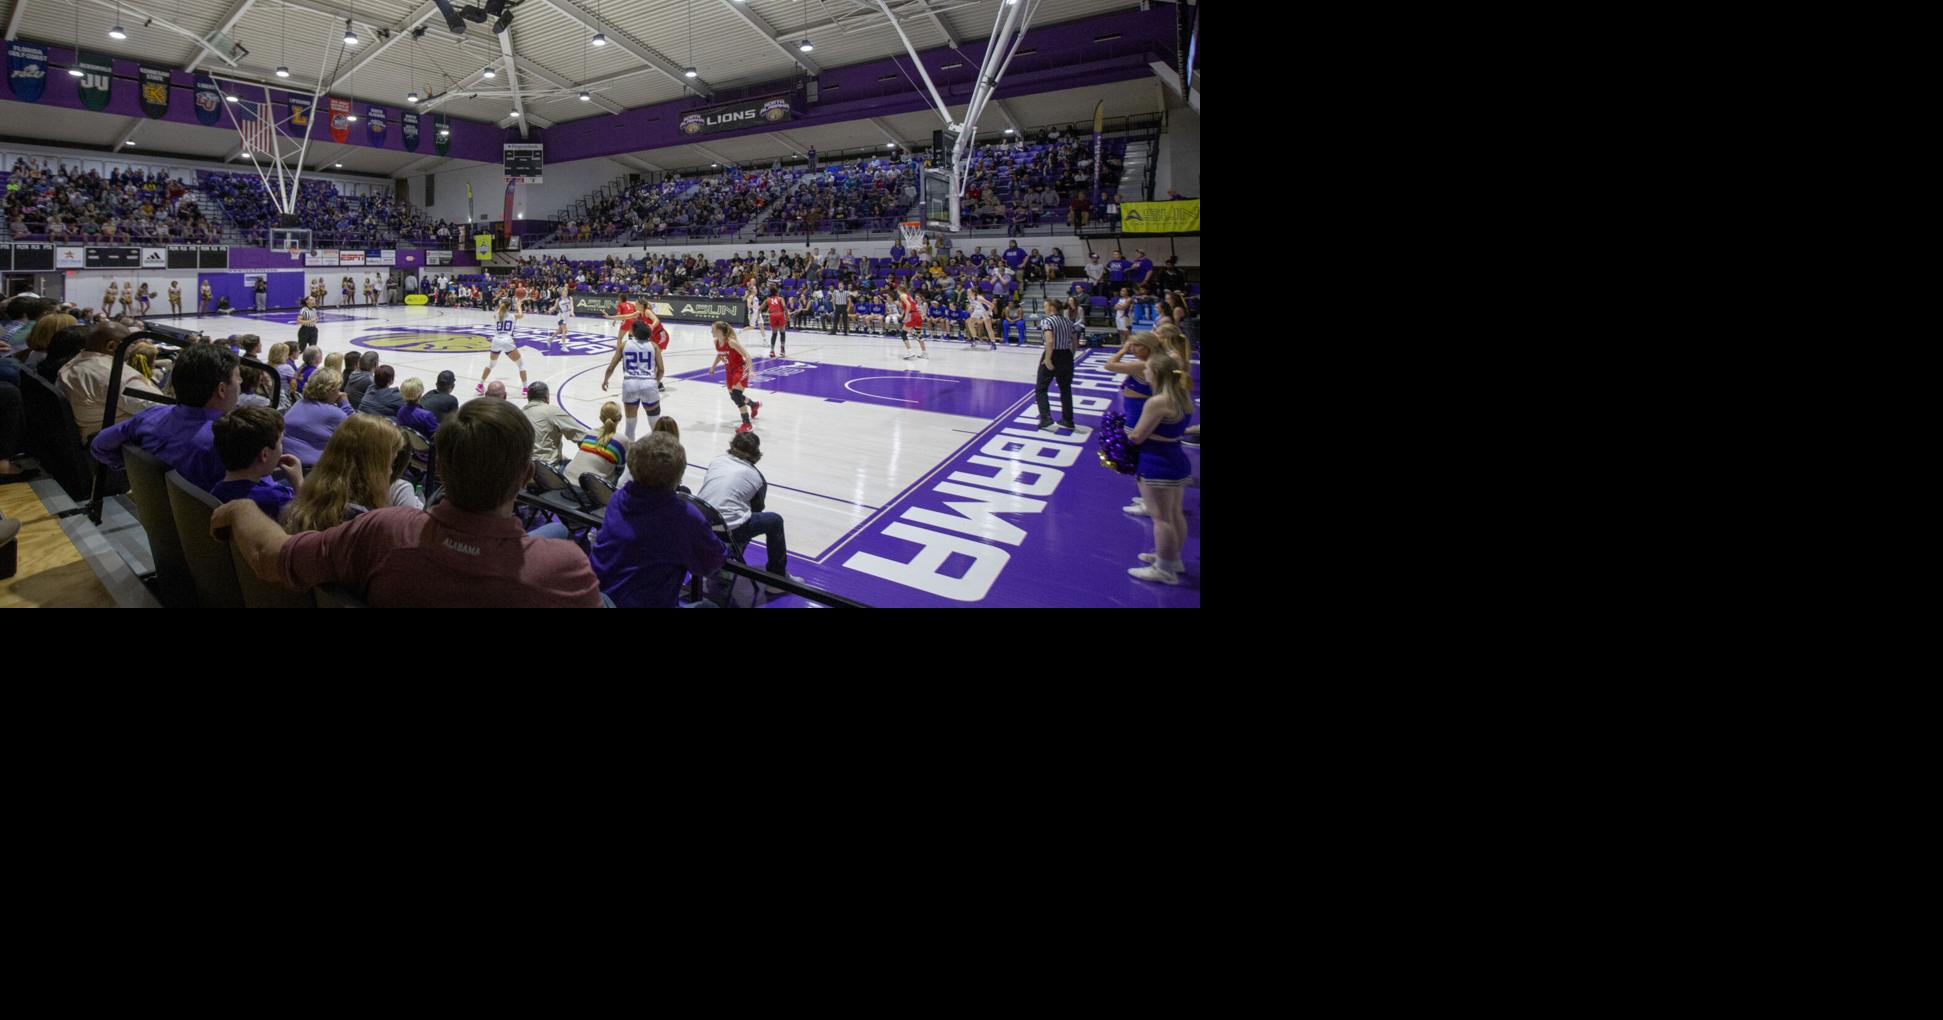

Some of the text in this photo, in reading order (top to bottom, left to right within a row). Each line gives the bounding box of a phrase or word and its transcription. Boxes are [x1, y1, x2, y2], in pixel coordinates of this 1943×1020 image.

[81, 73, 109, 91] JU
[706, 109, 756, 126] LIONS
[624, 352, 651, 370] 24
[842, 392, 1112, 601] ALABAMA
[443, 538, 480, 556] ALABAMA
